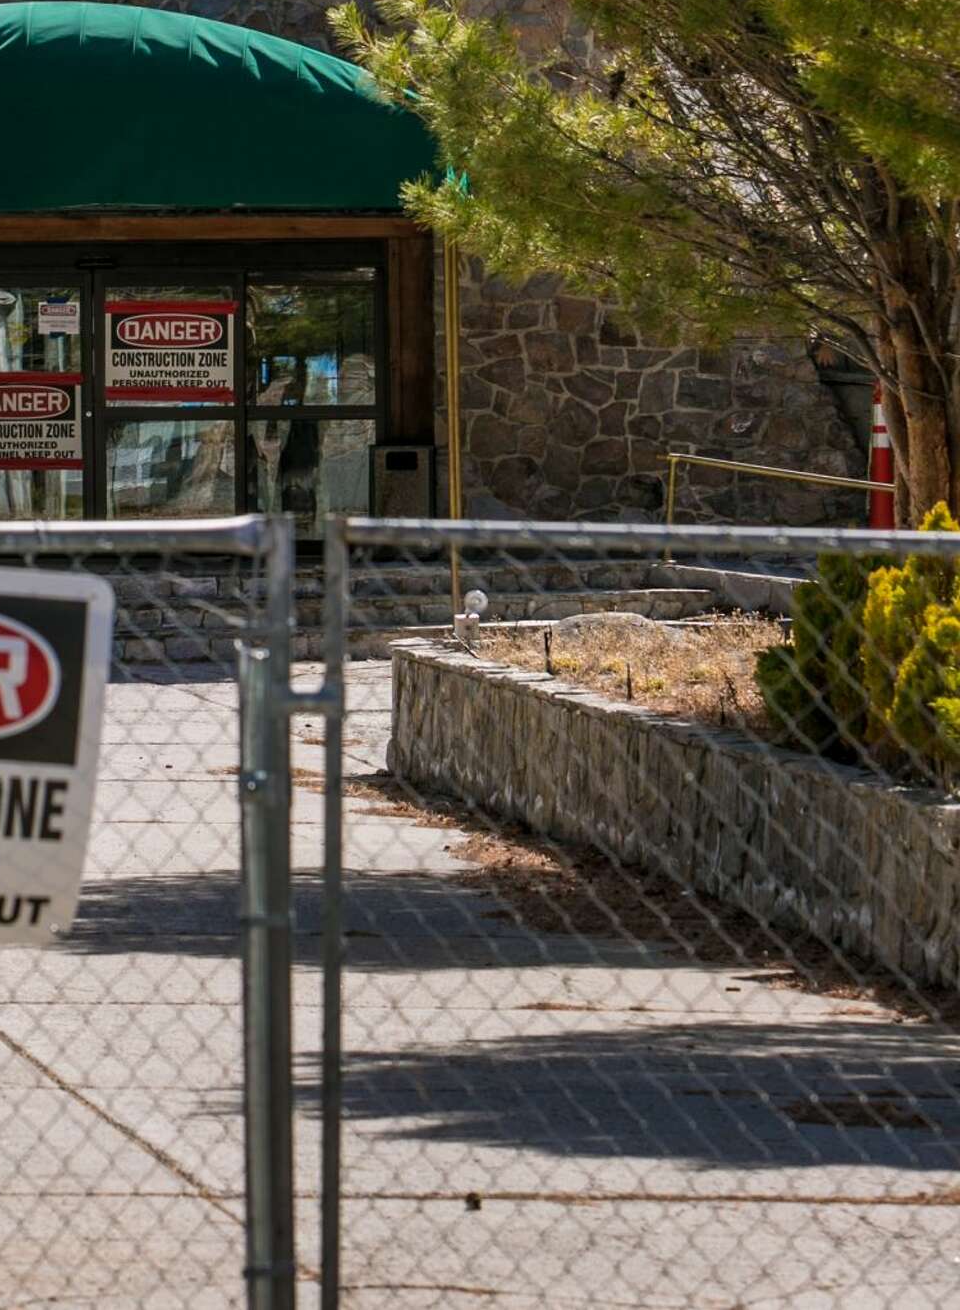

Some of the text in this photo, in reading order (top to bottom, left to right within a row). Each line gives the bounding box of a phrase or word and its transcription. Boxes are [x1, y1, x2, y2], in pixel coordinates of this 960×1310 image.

[124, 321, 216, 340] DANGER
[112, 352, 228, 368] CONSTRUCTION ZONE
[129, 370, 210, 378] UNAUTHORIZED
[112, 379, 228, 387] PERSONNEL KEEP OUT
[46, 423, 76, 438] ZONE
[25, 450, 52, 459] KEEP
[54, 450, 76, 459] OUT
